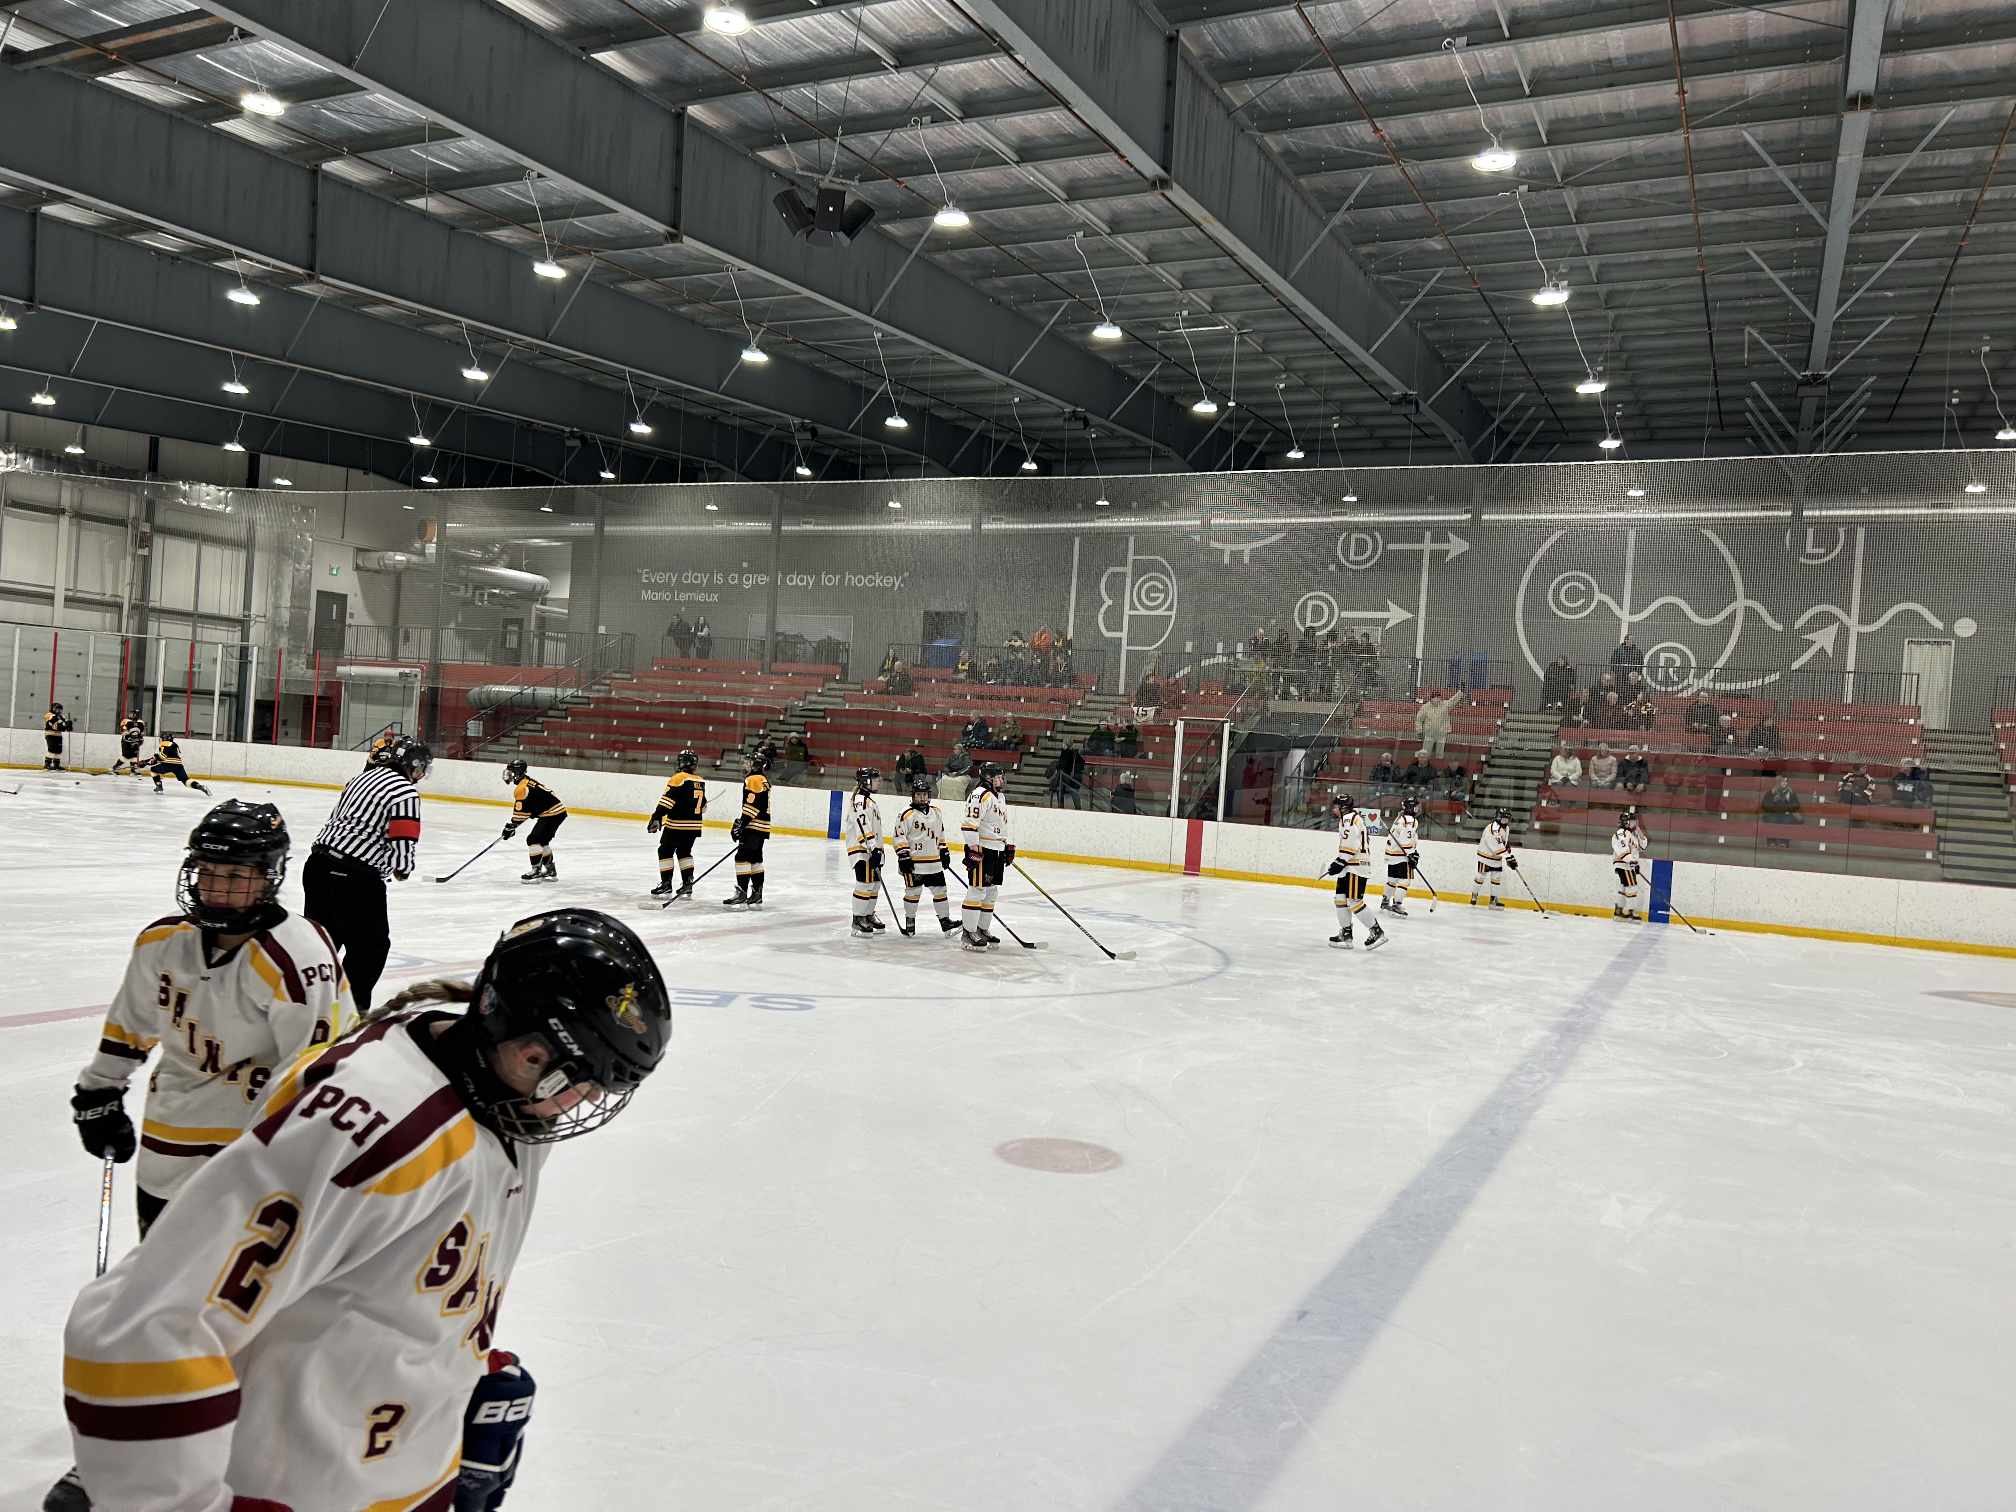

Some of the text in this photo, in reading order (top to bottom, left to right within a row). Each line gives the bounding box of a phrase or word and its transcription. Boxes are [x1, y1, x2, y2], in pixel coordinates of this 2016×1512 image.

[641, 590, 719, 602] Mario Lemieux
[682, 570, 710, 587] day
[713, 570, 724, 585] is
[728, 573, 738, 585] a
[743, 571, 782, 589] gret
[786, 570, 816, 589] day
[821, 571, 840, 586] for
[693, 790, 704, 815] 7
[548, 1017, 584, 1056] CCM
[299, 1084, 389, 1147] PCI
[208, 1191, 303, 1324] 2
[361, 1400, 410, 1463] 2
